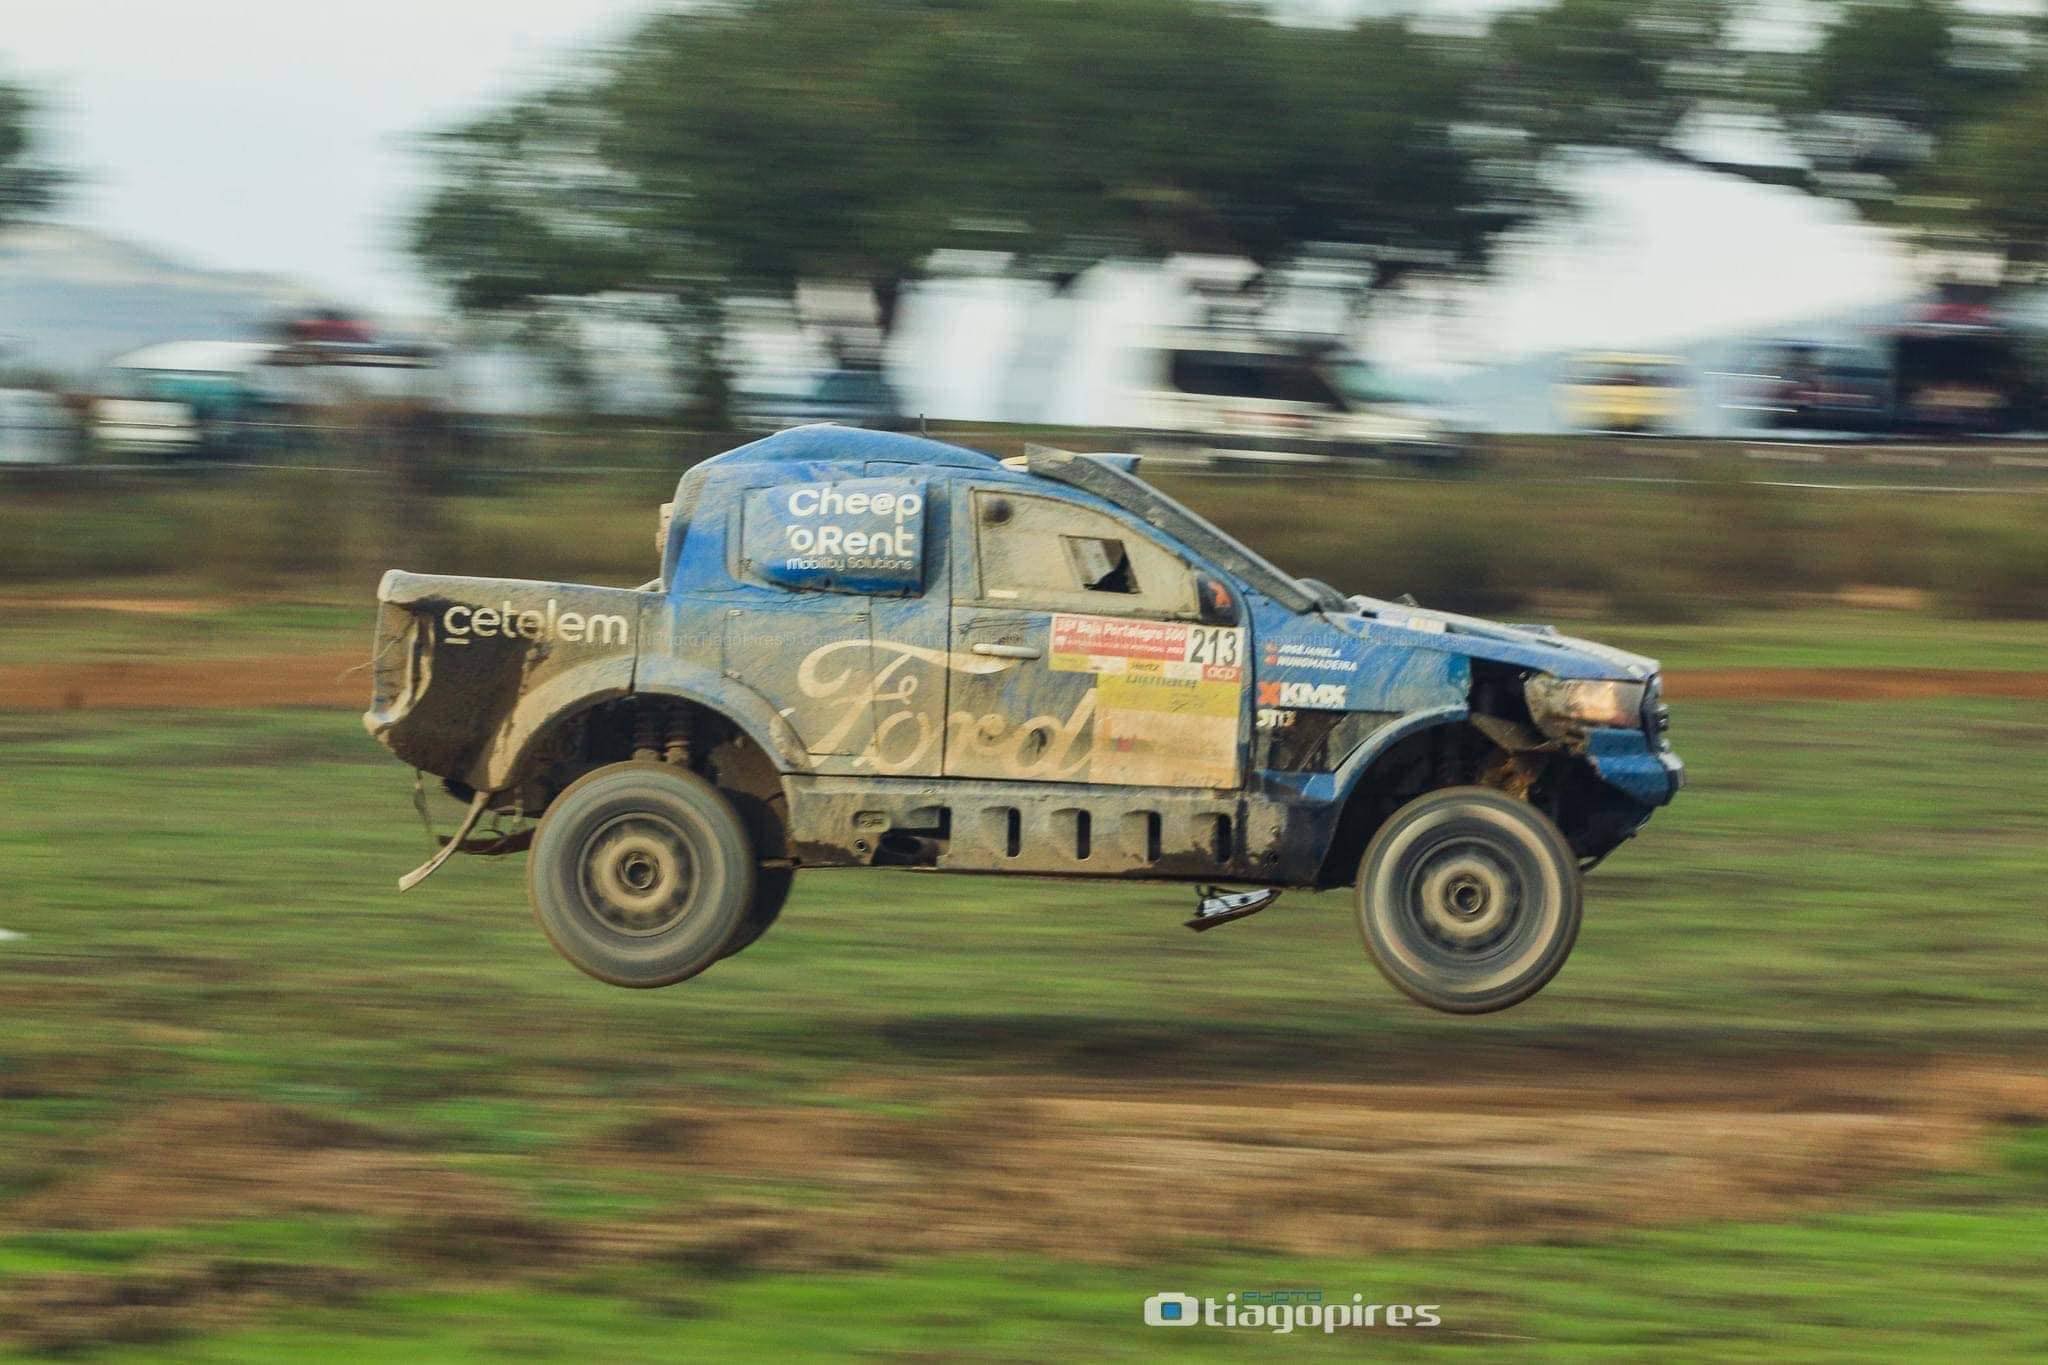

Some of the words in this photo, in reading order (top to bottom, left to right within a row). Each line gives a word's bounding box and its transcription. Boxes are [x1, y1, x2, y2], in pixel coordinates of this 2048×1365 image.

[443, 599, 628, 645] cetelem
[1189, 628, 1237, 667] 213
[797, 639, 1098, 776] Ford
